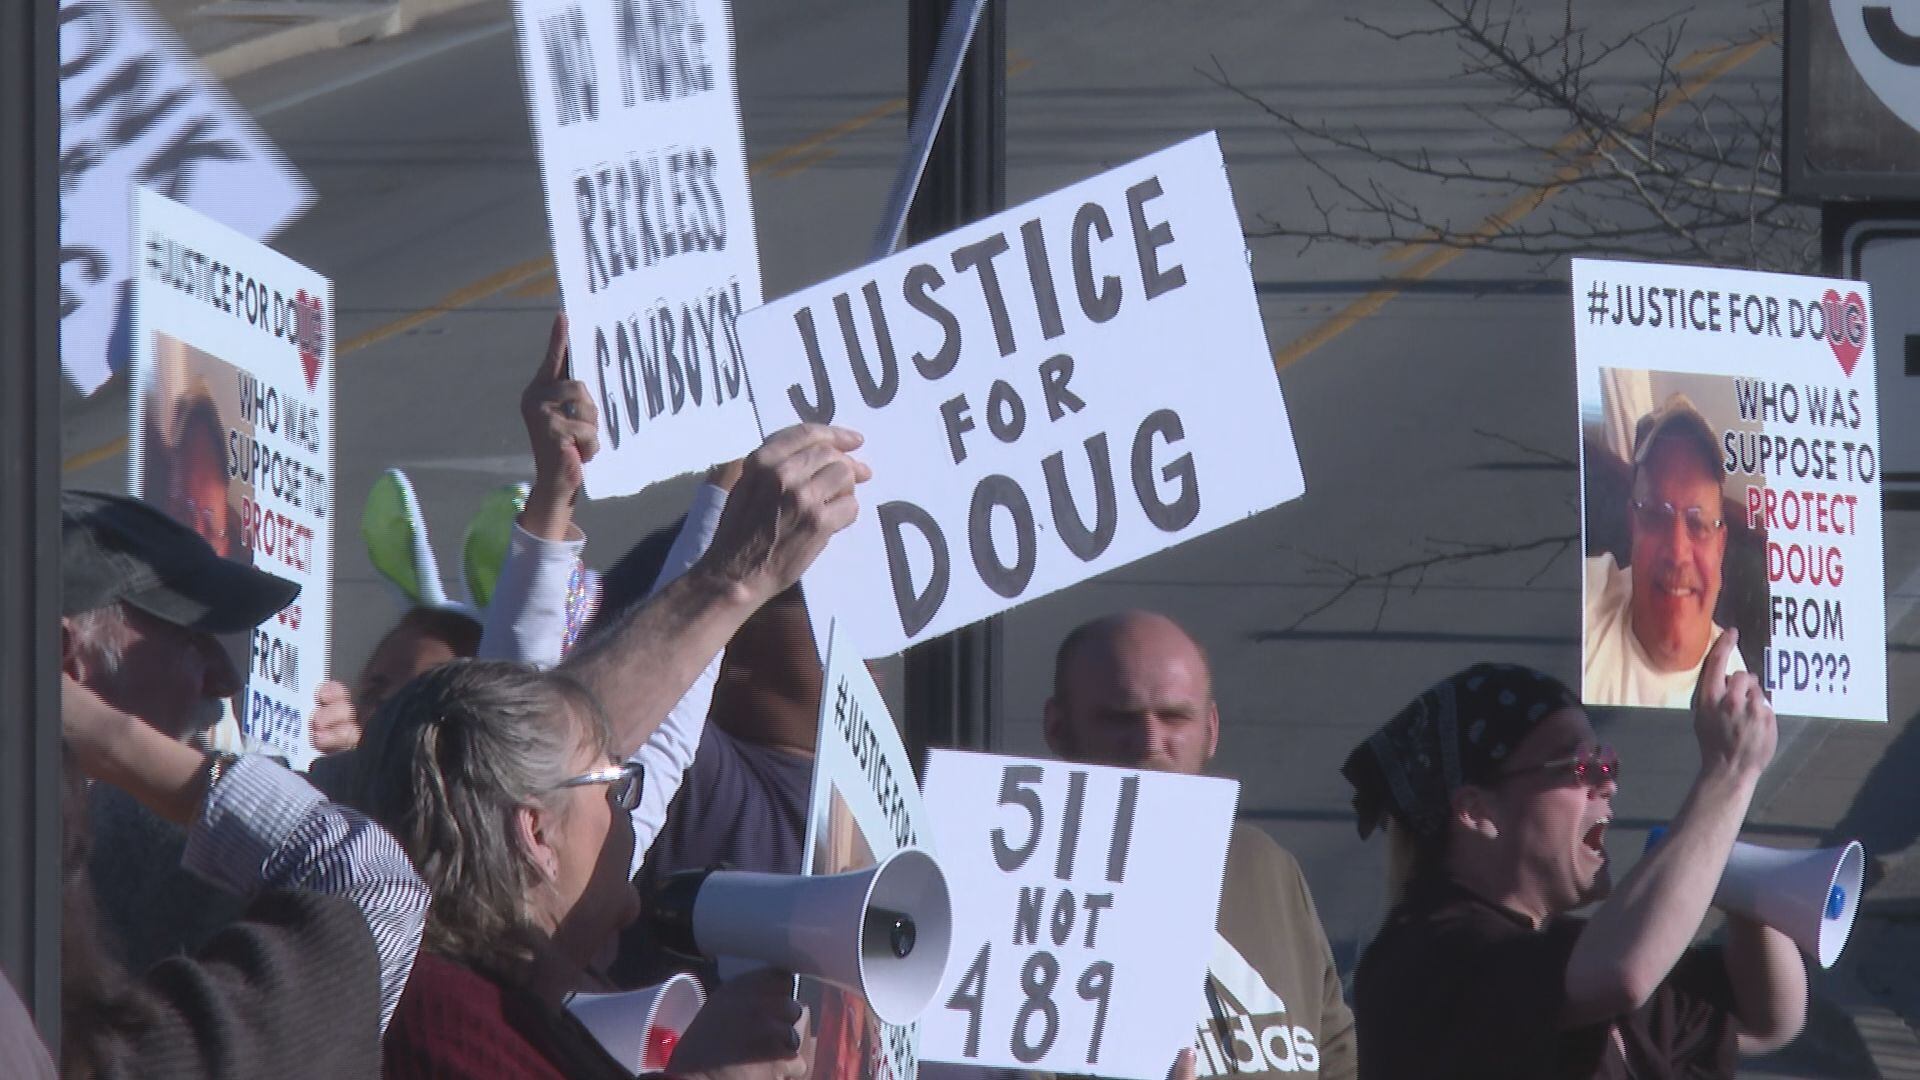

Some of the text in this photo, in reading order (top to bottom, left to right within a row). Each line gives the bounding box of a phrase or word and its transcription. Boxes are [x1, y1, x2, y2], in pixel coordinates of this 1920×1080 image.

[539, 4, 599, 126] NO
[573, 145, 727, 293] RECKLESS
[145, 231, 231, 314] #JUSTICE
[235, 271, 270, 332] FOR
[273, 290, 324, 360] DOUG
[787, 176, 1187, 425] JUSTICE
[1588, 281, 1866, 346] #JUSTICE FOR DOUG
[237, 371, 320, 454] WHO WAS
[939, 354, 1086, 465] FOR
[1735, 378, 1861, 429] WHO WAS
[227, 430, 327, 520] SUPPOSE TO
[1724, 430, 1875, 483] SUPPOSE TO
[241, 496, 314, 575] PROTECT
[877, 408, 1201, 638] DOUG
[1746, 487, 1857, 535] PROTECT
[1767, 542, 1843, 587] DOUG
[1772, 596, 1843, 640] FROM
[251, 627, 299, 692] FROM
[1764, 646, 1851, 693] LPD???
[243, 684, 301, 755] LPD???
[834, 675, 891, 816] #JUSTICE
[990, 765, 1140, 883] 511
[1013, 886, 1114, 949] NOT
[945, 942, 1114, 1064] 489
